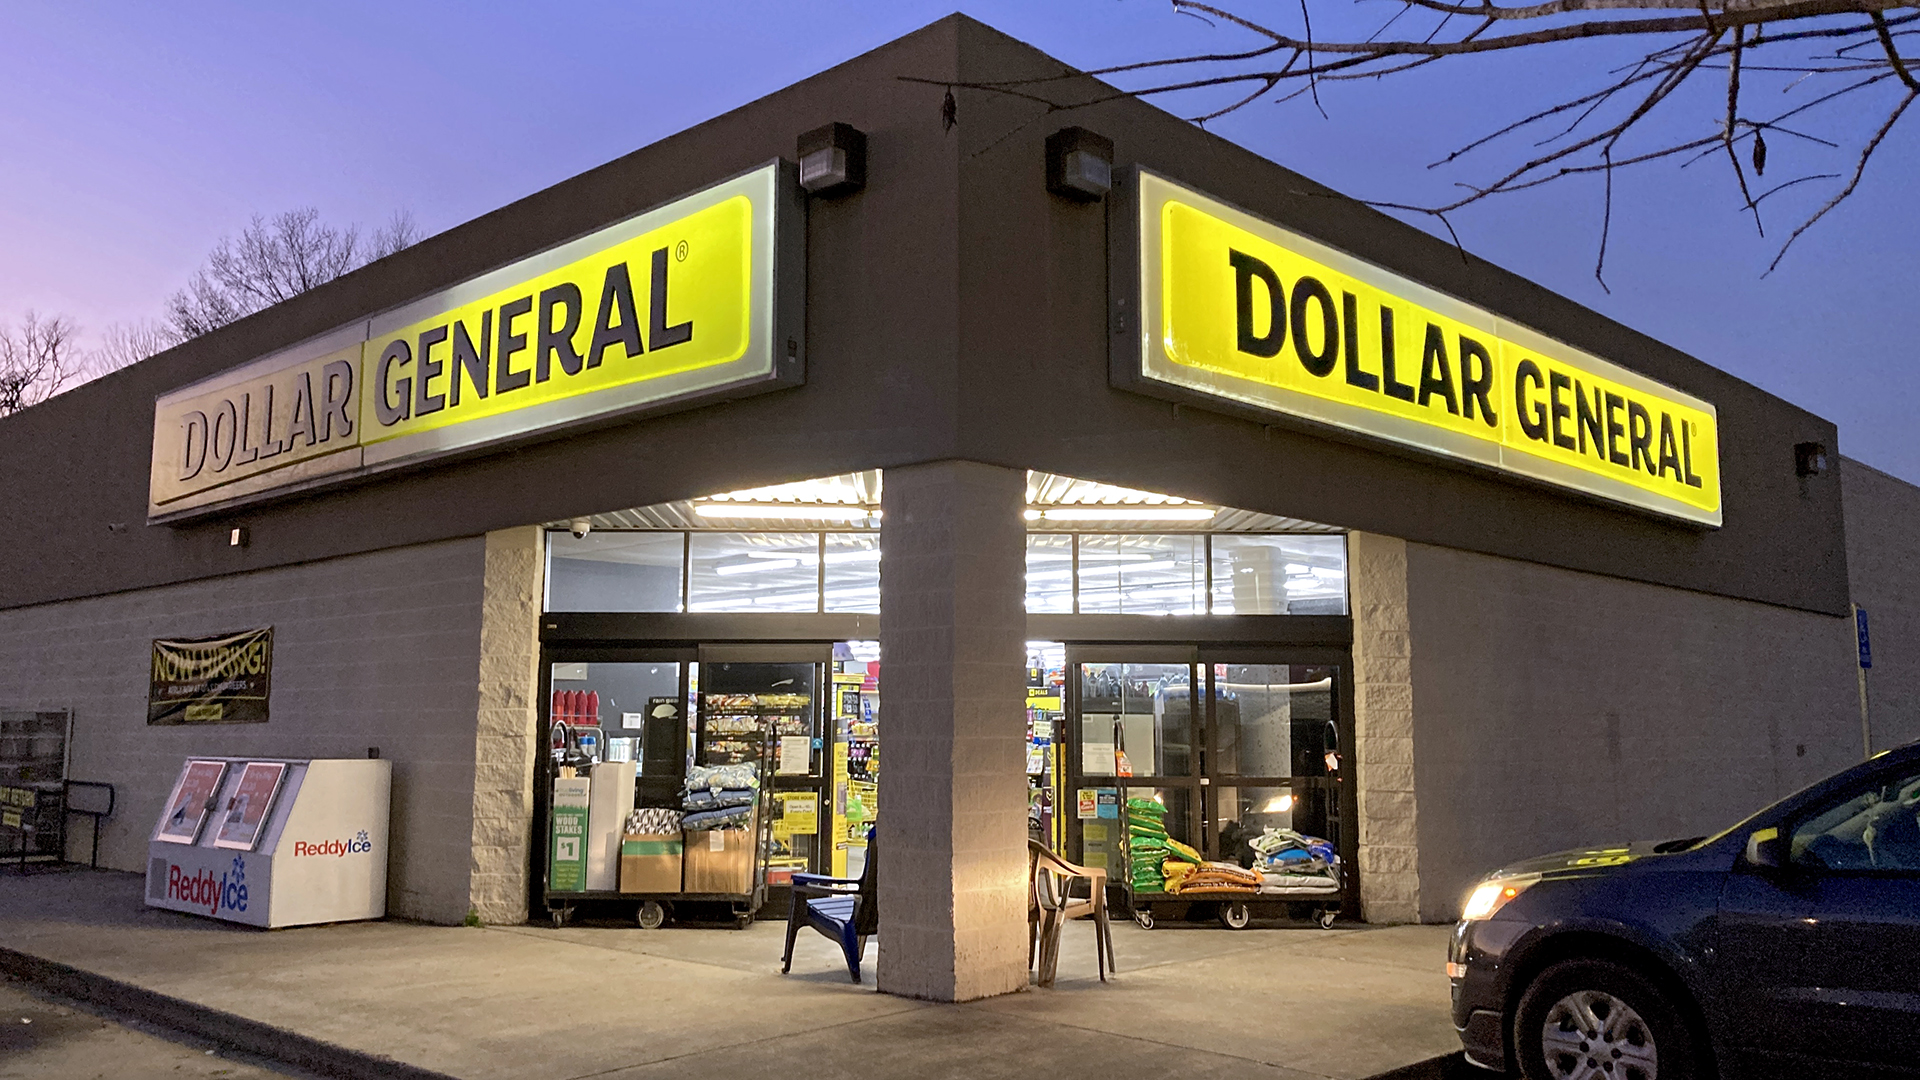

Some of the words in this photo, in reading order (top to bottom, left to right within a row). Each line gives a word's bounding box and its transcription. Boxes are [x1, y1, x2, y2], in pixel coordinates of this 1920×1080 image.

[179, 360, 353, 481] DOLLAR
[374, 246, 693, 427] GENERAL
[1229, 248, 1499, 428] DOLLAR
[1515, 360, 1703, 489] GENERAL
[556, 817, 579, 826] WOOD
[556, 826, 583, 835] STAKES
[294, 838, 372, 858] ReddyIce
[561, 842, 574, 857] $1
[168, 864, 249, 915] ReddyIce
